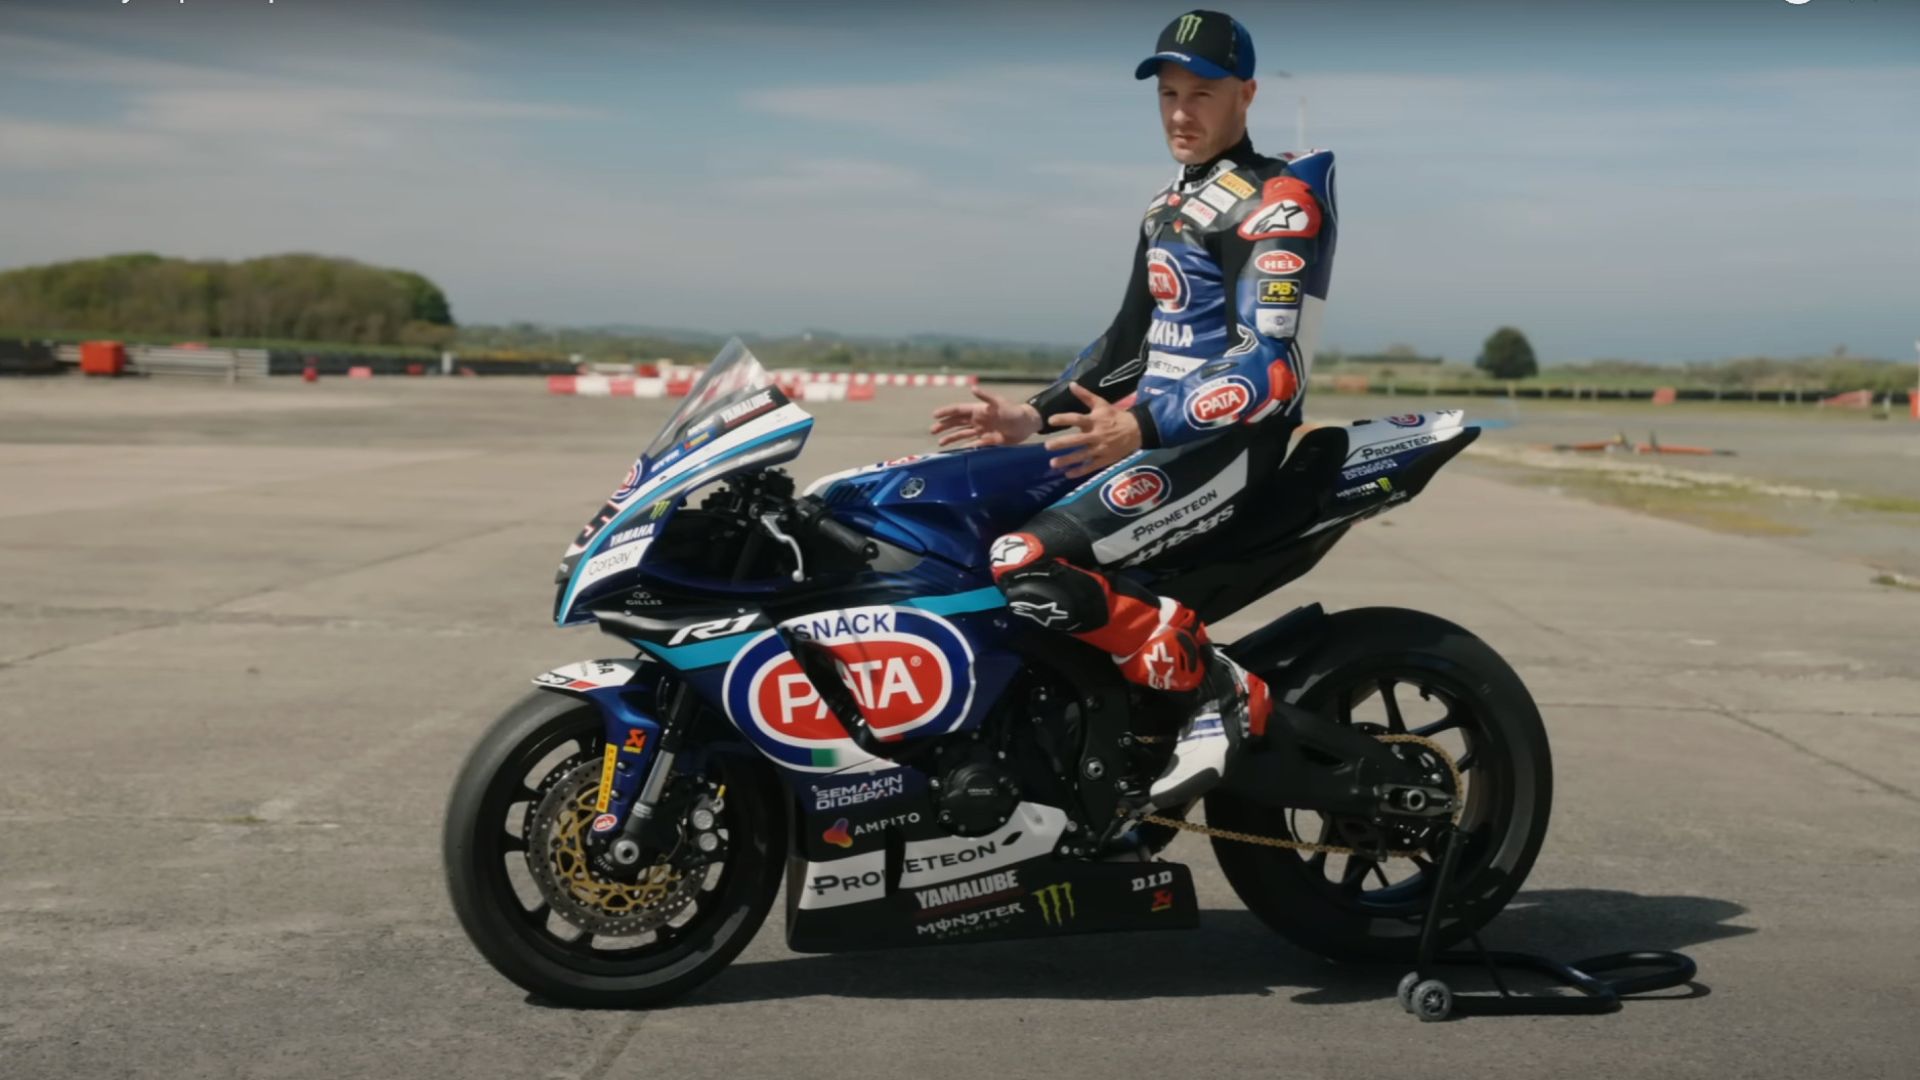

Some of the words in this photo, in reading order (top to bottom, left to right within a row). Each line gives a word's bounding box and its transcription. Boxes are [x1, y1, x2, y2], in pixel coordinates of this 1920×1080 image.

[1263, 260, 1297, 269] HEL
[1268, 281, 1293, 295] PB
[1198, 389, 1242, 418] PATA
[1361, 435, 1438, 460] PROMETEON
[1115, 477, 1157, 504] PATA
[1132, 489, 1218, 542] PROMETEON
[609, 522, 656, 548] YAMAHA
[588, 551, 632, 576] Corpay
[667, 612, 761, 646] R1
[793, 612, 892, 641] SNACK
[815, 774, 903, 801] SEMAKIN
[837, 783, 903, 808] DEPAN
[853, 811, 921, 836] AMPITO
[807, 841, 997, 896] PROETEON
[914, 869, 1020, 910] YAMALUBE
